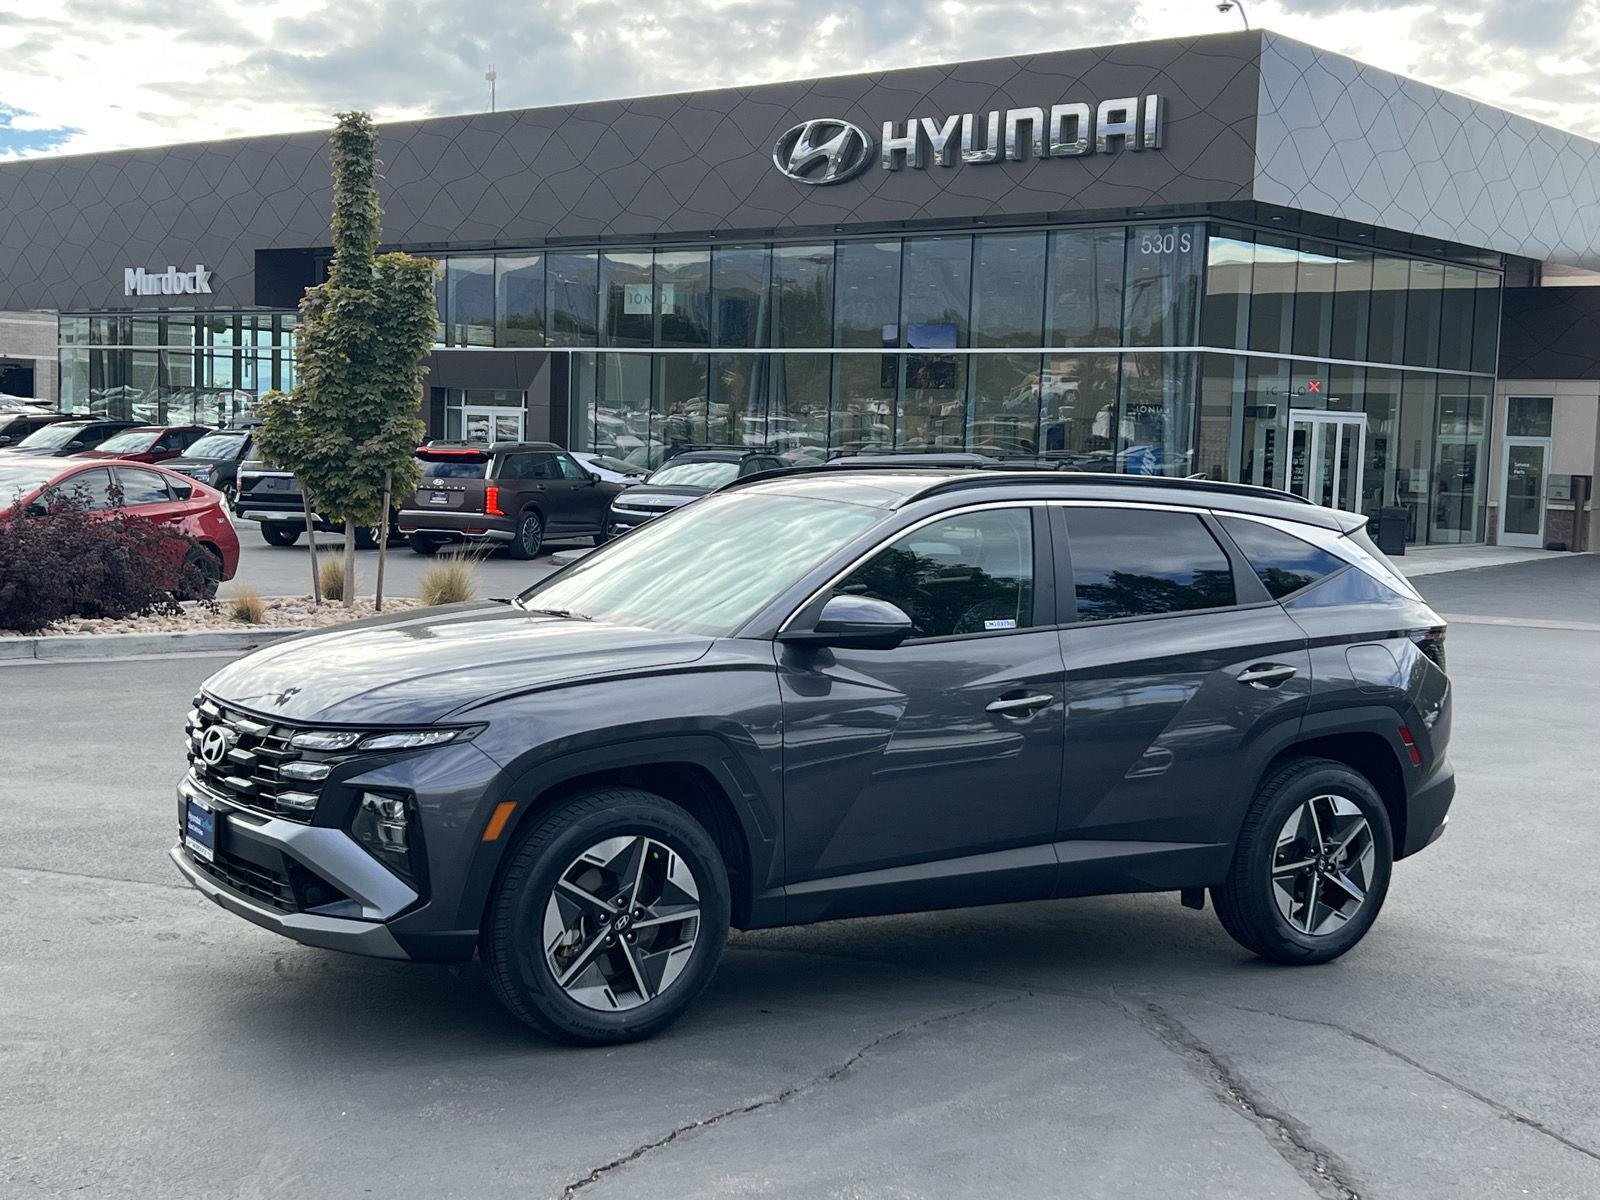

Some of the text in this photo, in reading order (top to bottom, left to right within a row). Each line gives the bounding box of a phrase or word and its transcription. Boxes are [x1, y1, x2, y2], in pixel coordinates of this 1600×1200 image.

[881, 94, 1163, 171] HYUNDAI
[1141, 233, 1191, 254] 530 S
[124, 264, 213, 296] Murdock
